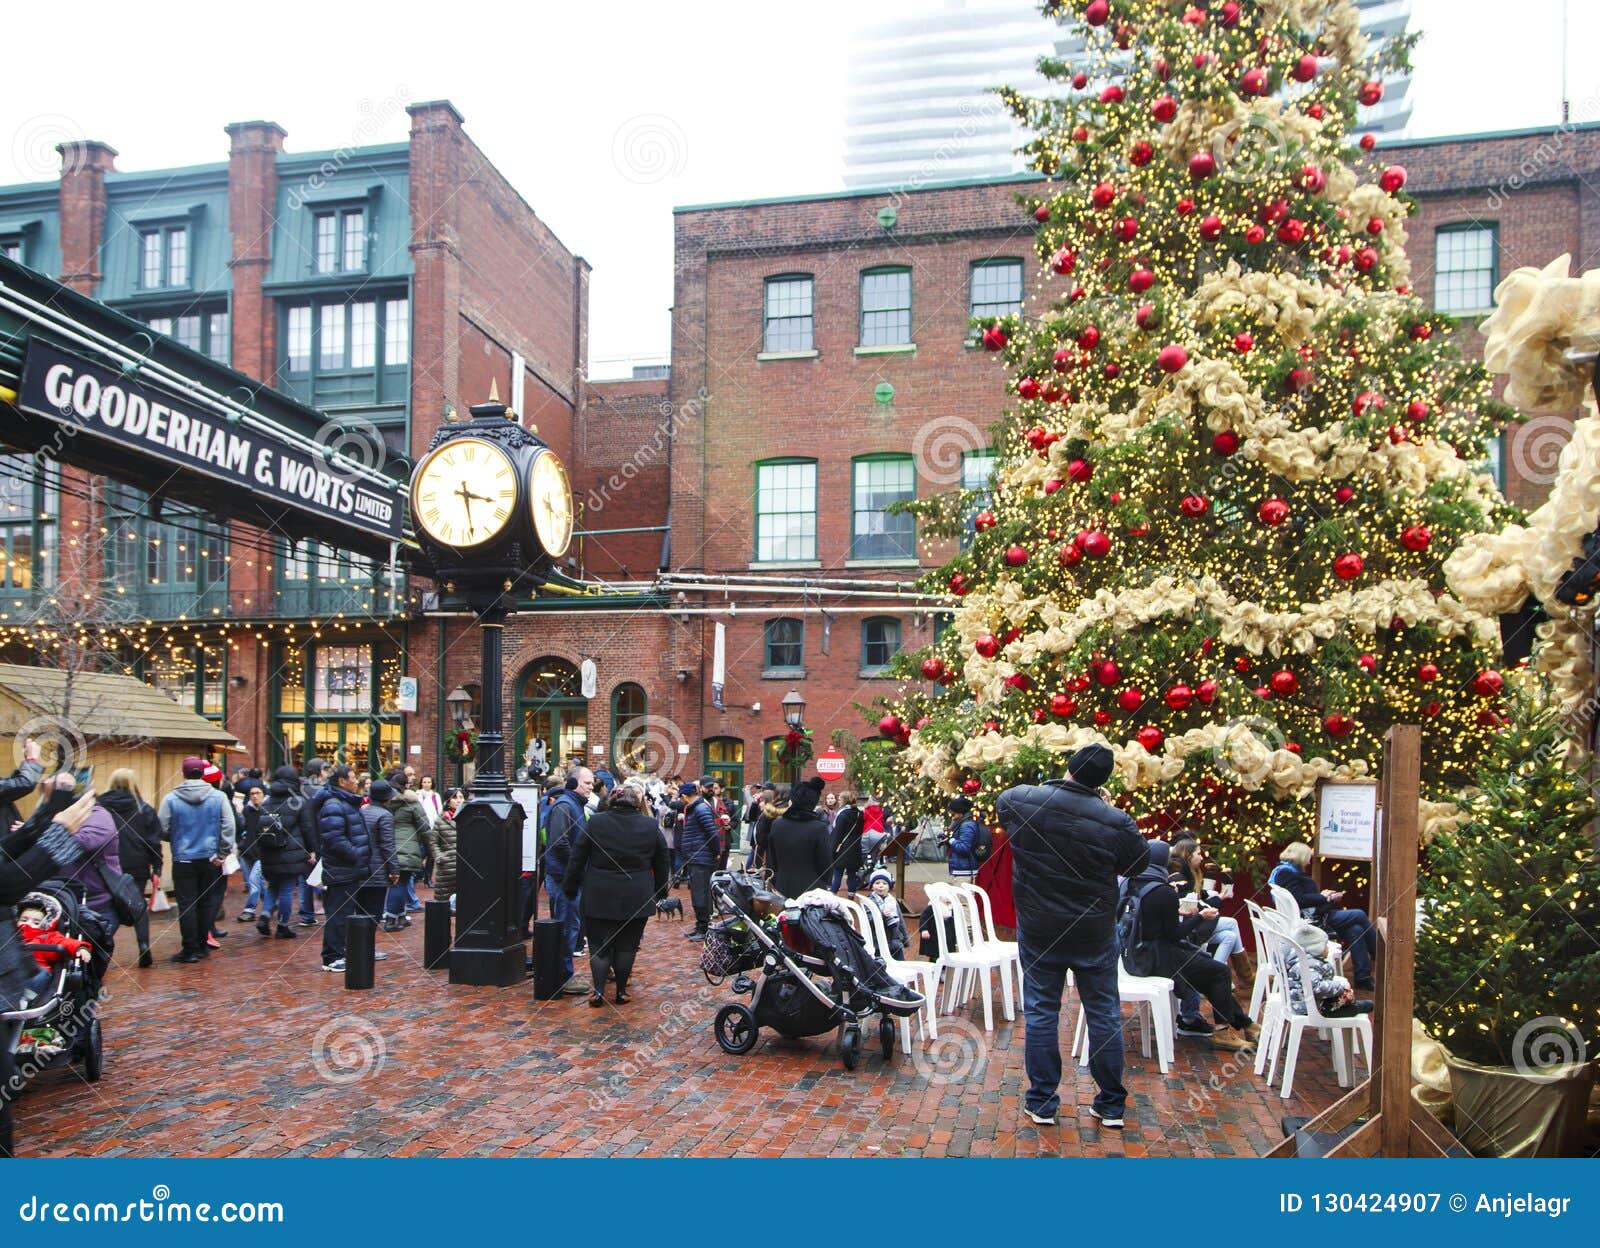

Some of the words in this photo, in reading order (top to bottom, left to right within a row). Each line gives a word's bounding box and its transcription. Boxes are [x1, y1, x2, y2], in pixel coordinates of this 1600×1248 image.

[45, 363, 251, 476] GOODERHAM
[255, 448, 274, 487] &
[279, 460, 356, 515] WORTS
[356, 492, 392, 521] LIMITED
